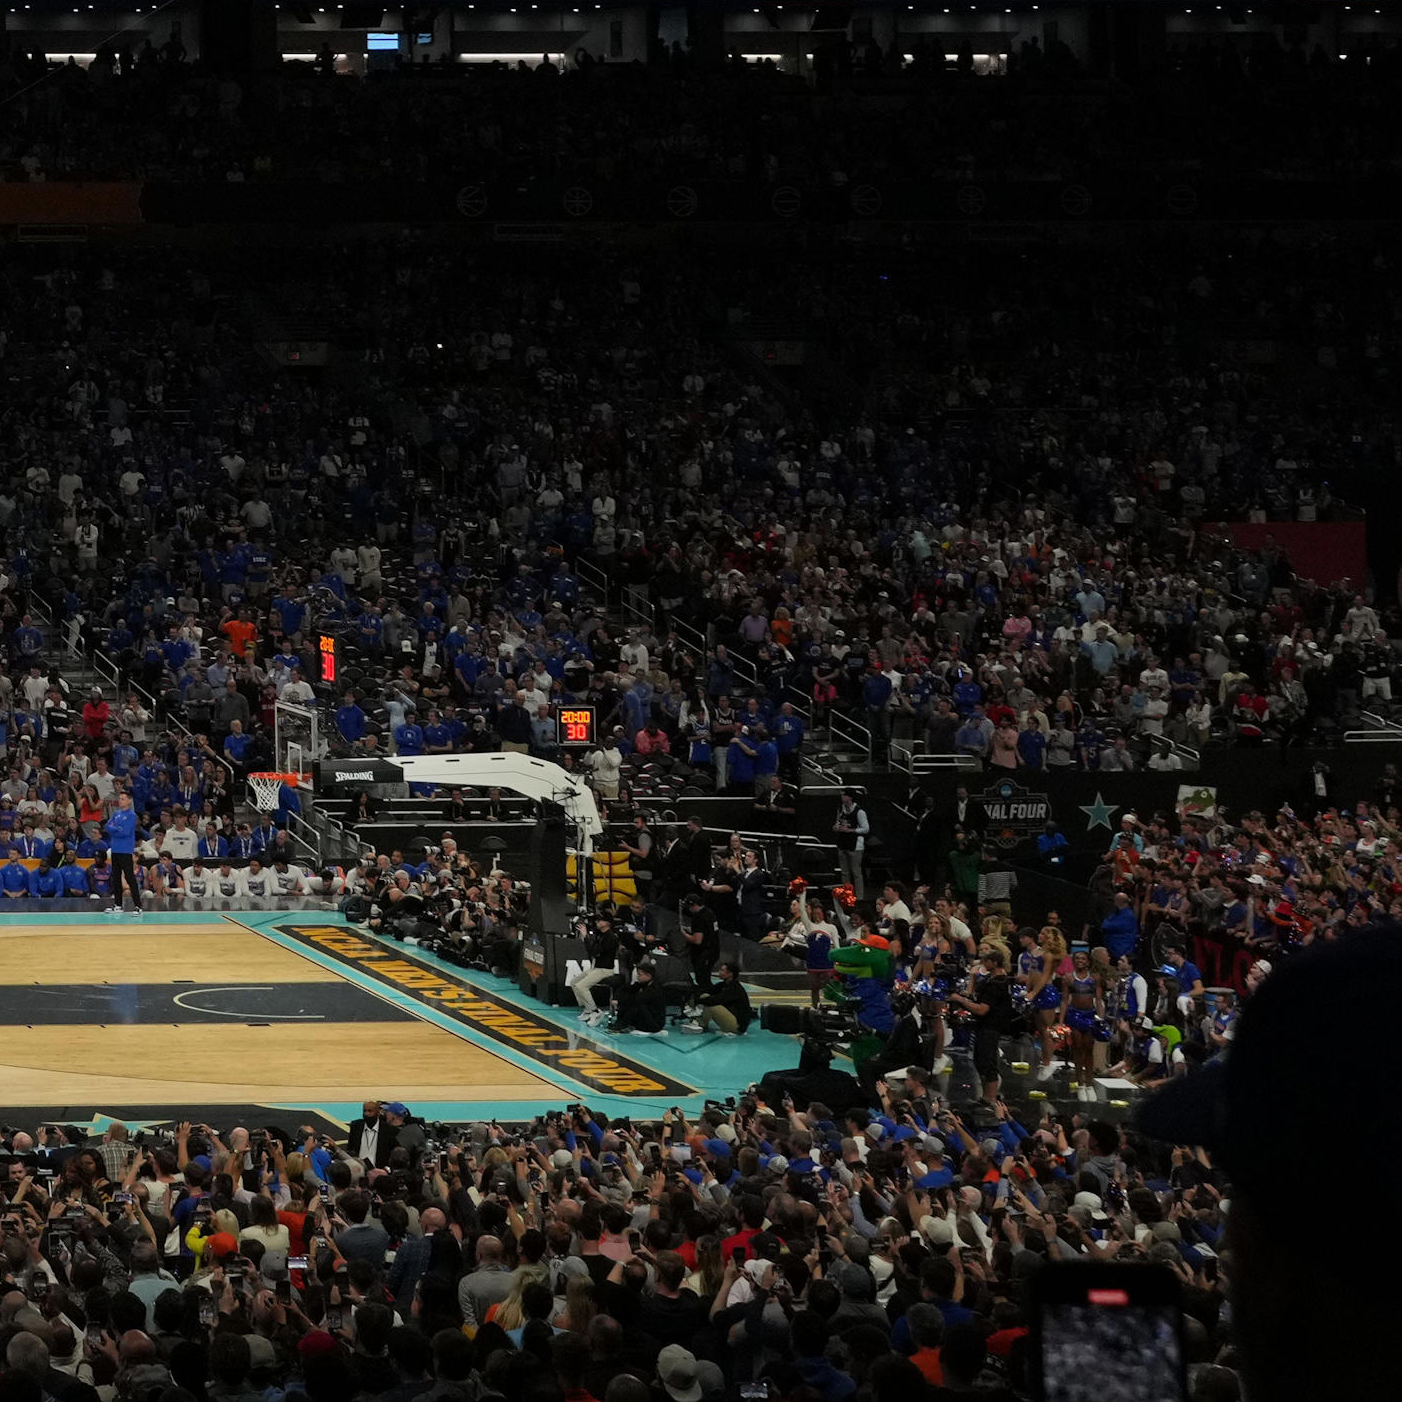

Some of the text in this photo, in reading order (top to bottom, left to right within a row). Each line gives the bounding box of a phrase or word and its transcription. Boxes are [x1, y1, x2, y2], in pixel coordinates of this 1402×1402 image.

[561, 711, 590, 723] 20:00
[567, 724, 587, 740] 30
[335, 771, 374, 782] SPALDING
[1010, 804, 1047, 818] FOUR
[291, 927, 389, 959] NCAA
[445, 1002, 567, 1046] FINAL
[536, 1048, 667, 1093] FOUR
